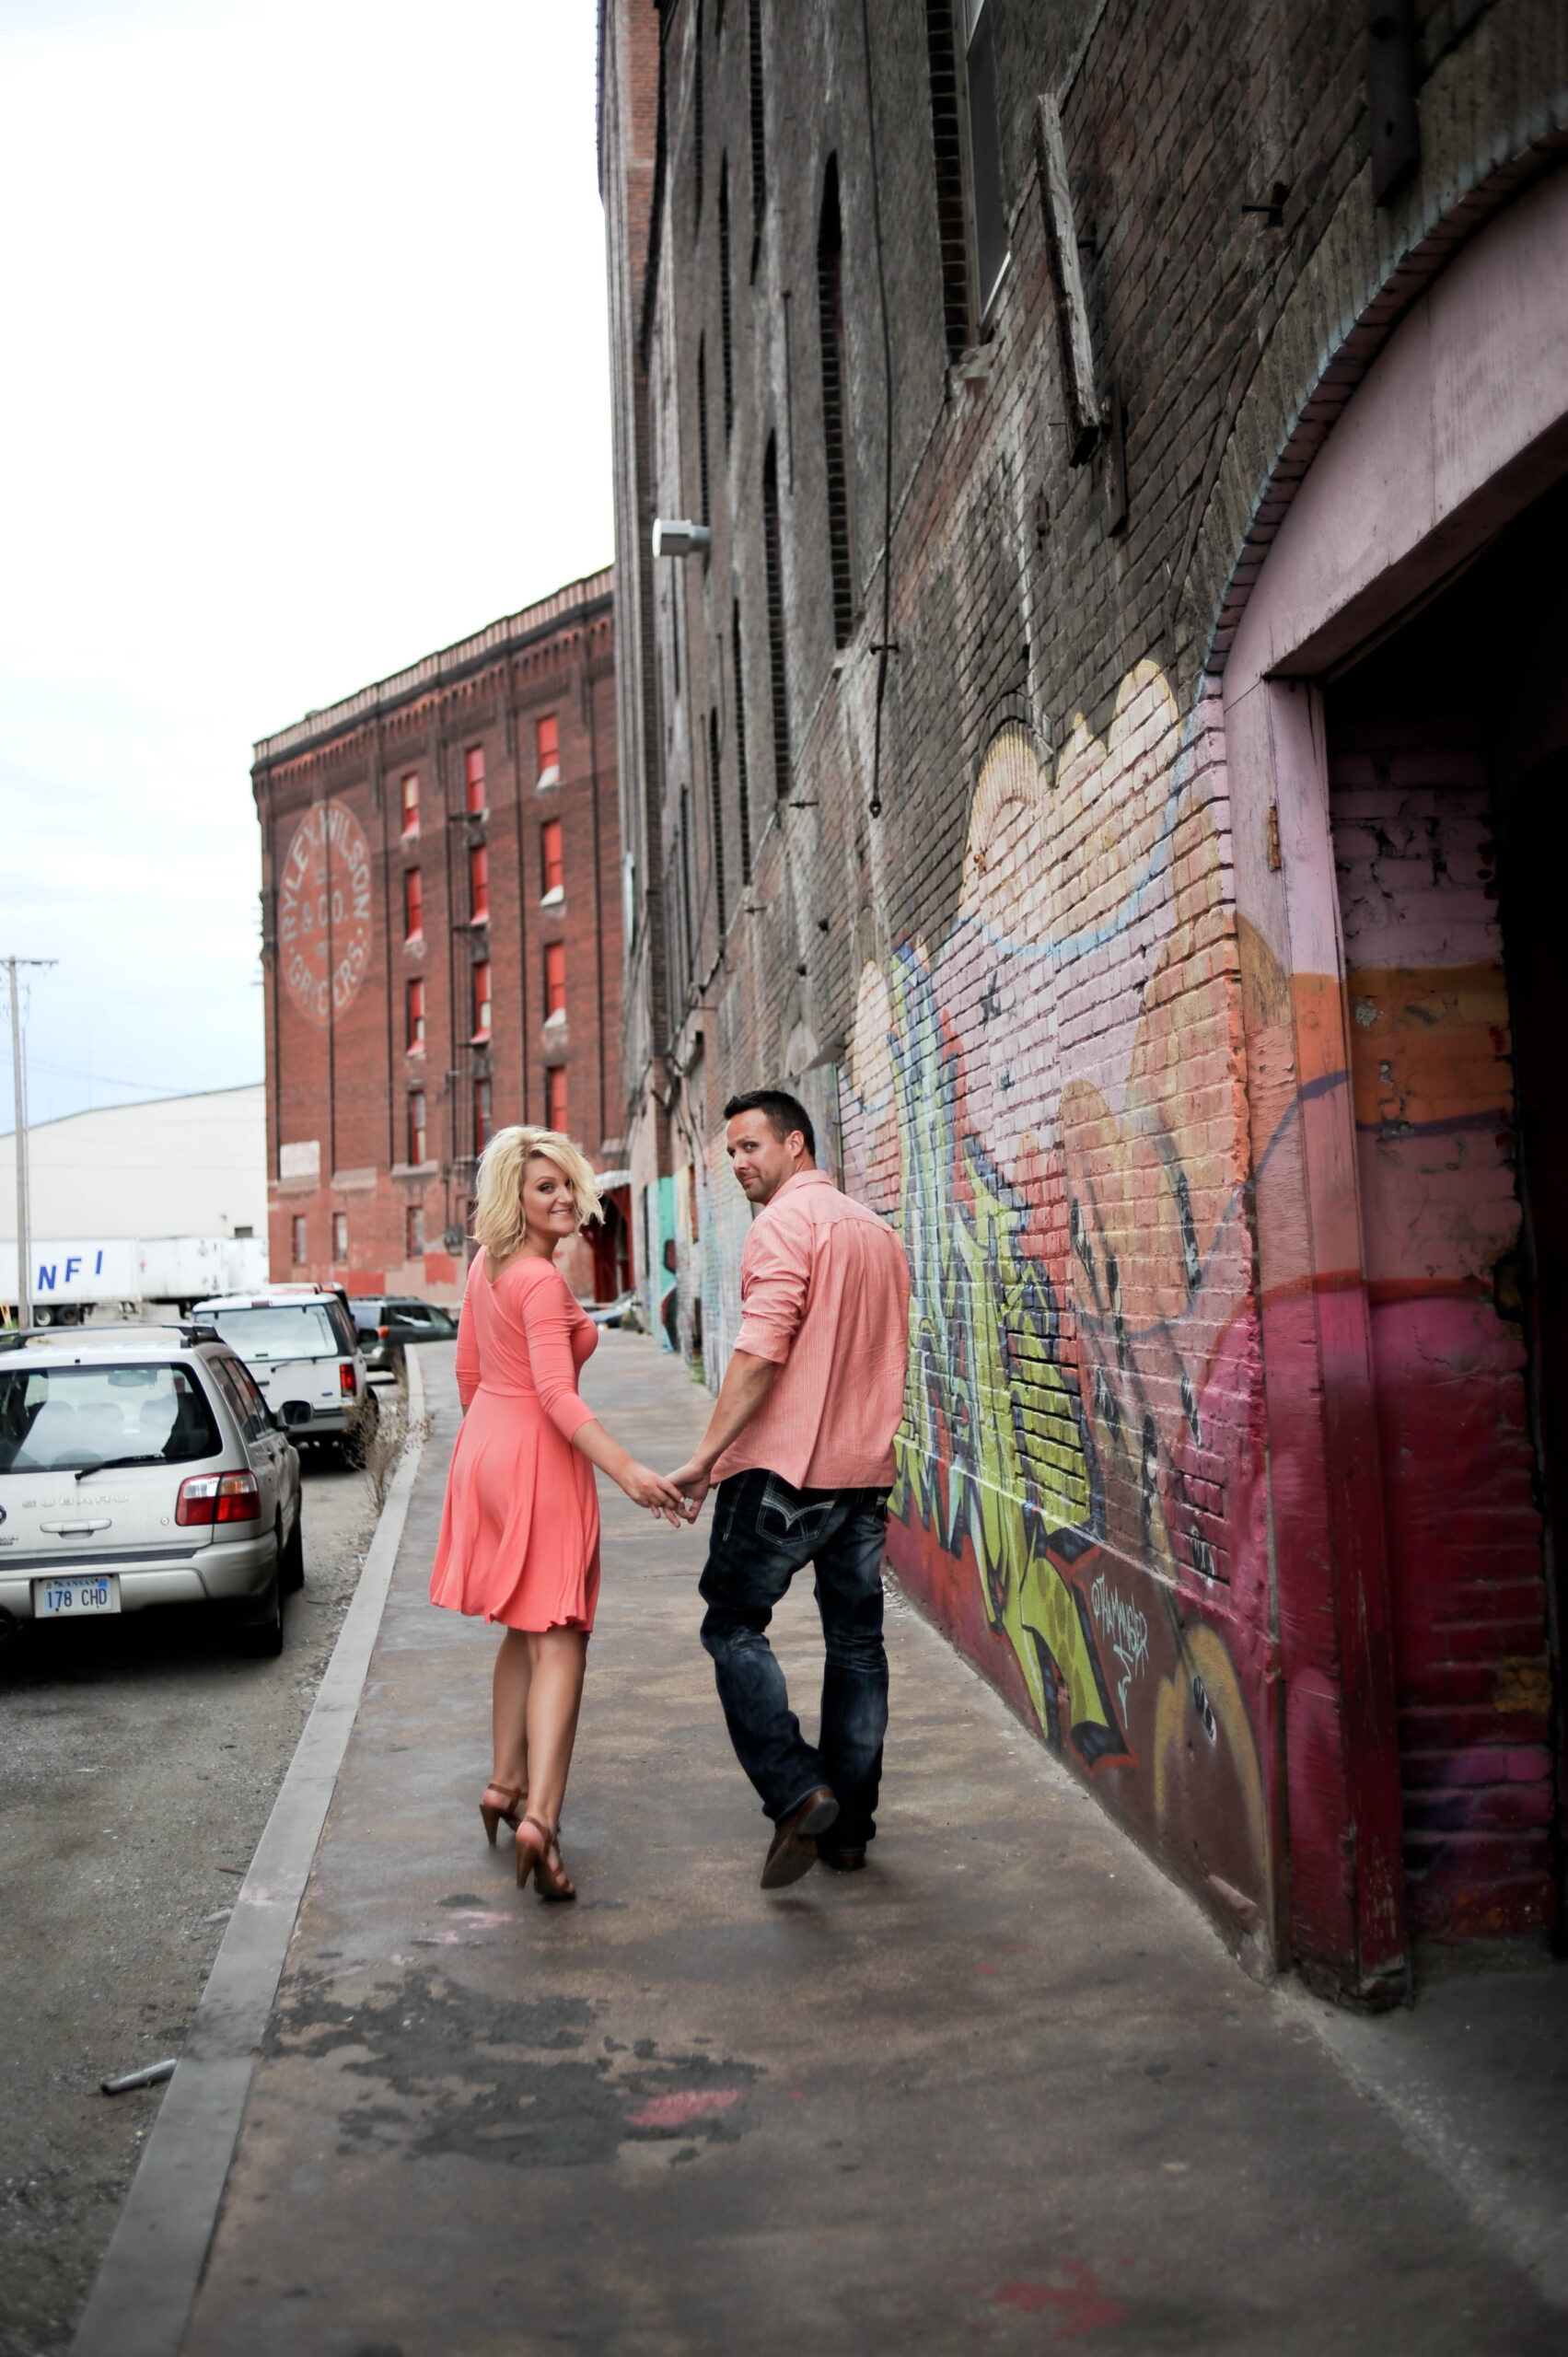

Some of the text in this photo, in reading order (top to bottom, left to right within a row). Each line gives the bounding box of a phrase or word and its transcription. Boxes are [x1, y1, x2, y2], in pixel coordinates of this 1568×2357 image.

[319, 808, 371, 919] WILSON
[38, 1249, 103, 1290] NFI
[22, 1492, 129, 1508] SUBARU
[57, 1578, 96, 1588] KANSAS
[47, 1587, 108, 1609] 178 CHD
